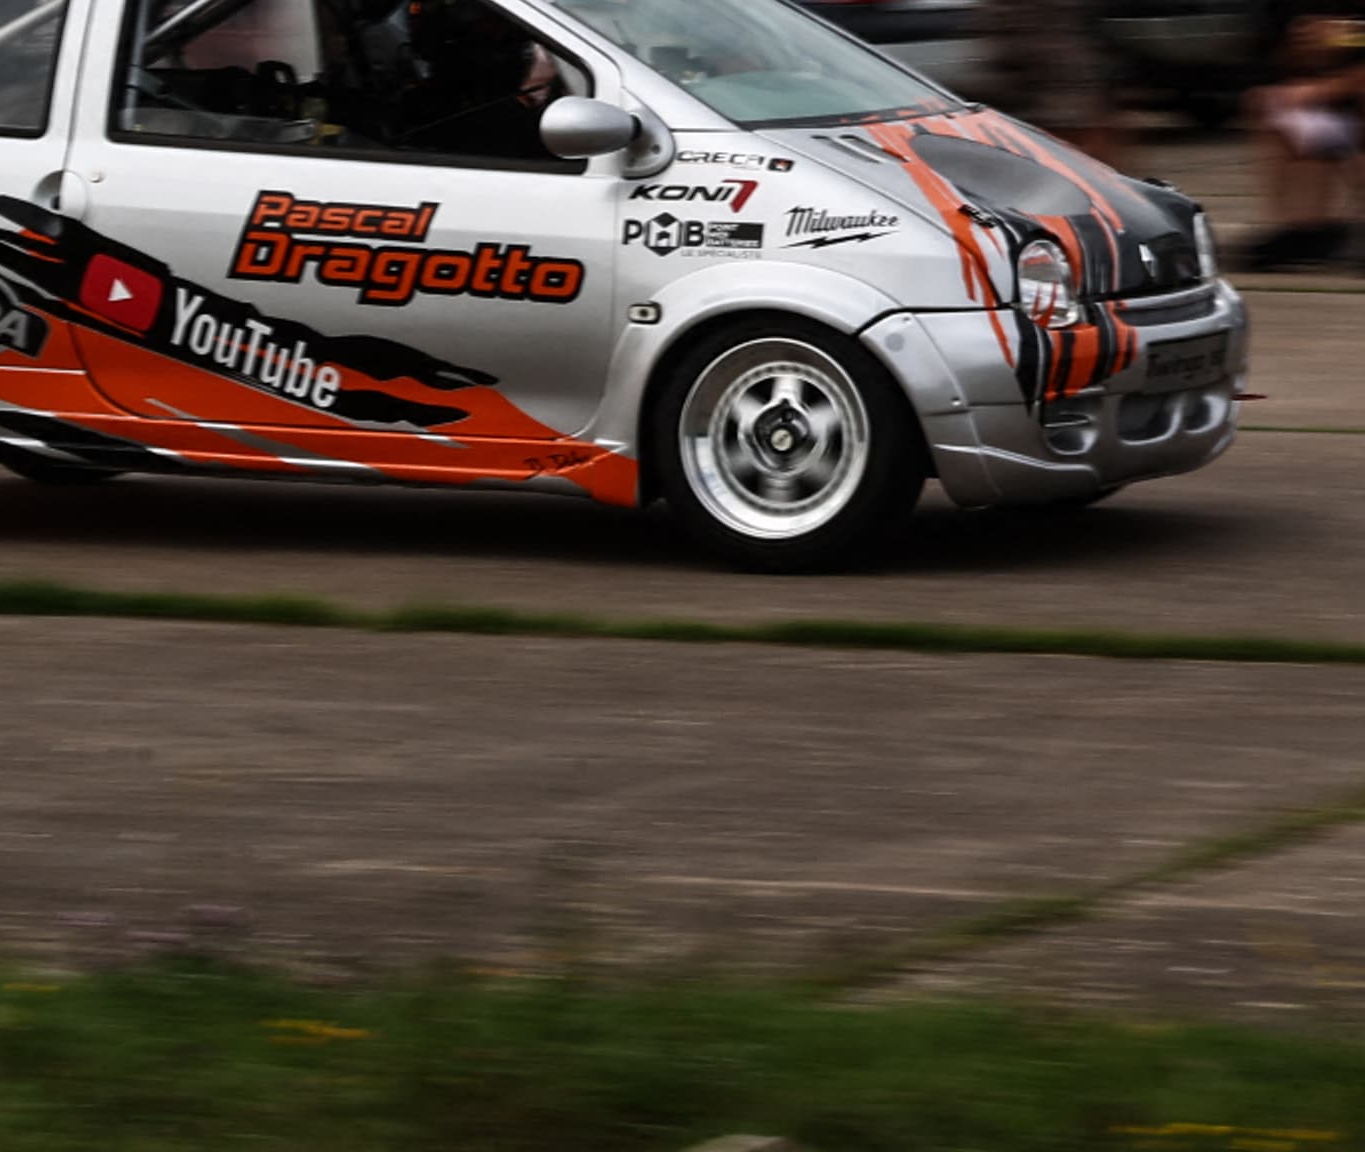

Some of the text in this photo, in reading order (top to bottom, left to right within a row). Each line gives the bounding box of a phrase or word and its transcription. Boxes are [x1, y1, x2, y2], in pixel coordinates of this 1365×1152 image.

[249, 192, 439, 240] Pascal
[629, 185, 735, 201] KONI
[784, 206, 899, 237] Milwaukee
[230, 230, 584, 305] Dragotto
[170, 287, 342, 409] YouTube
